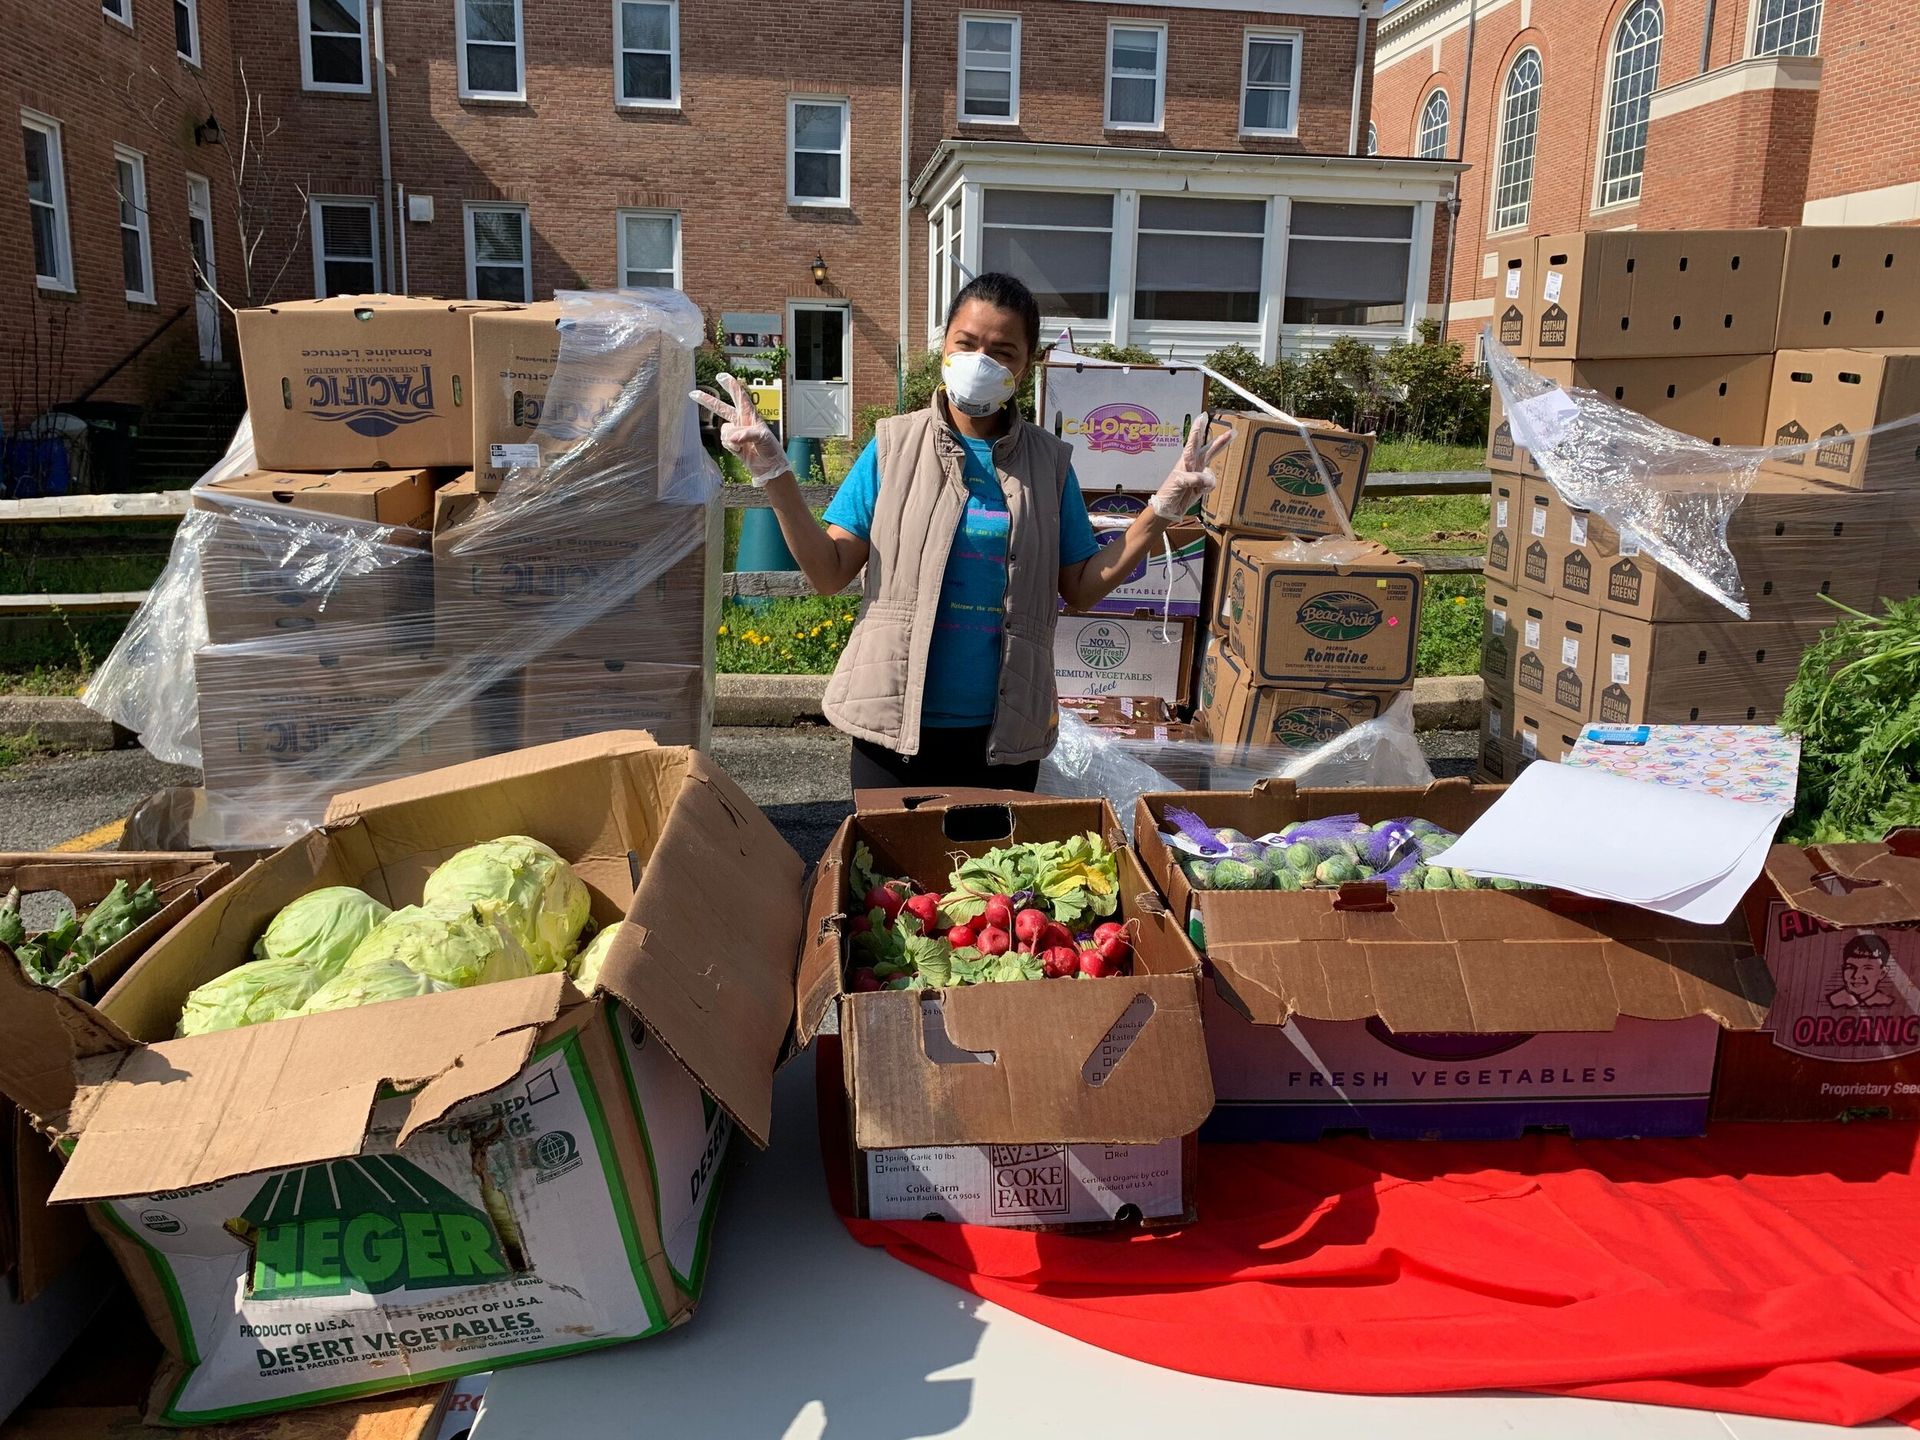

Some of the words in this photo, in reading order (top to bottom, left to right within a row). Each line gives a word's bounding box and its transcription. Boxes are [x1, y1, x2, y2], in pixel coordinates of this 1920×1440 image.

[1502, 320, 1522, 331] GOTHAM
[1543, 320, 1566, 331] GOTHAM
[1501, 331, 1521, 342] GREENS
[1542, 331, 1565, 342] GREENS
[302, 349, 359, 357] Lettuce
[366, 348, 432, 357] Romaine
[357, 366, 419, 374] INTERNATIONAL
[500, 371, 553, 380] ettuce
[306, 364, 435, 409] PACIFIC
[1063, 416, 1180, 442] Cal-Organic
[1820, 450, 1849, 467] GREENS
[1273, 462, 1337, 488] BeachS
[1270, 499, 1326, 519] Romaine
[1527, 553, 1547, 568] GOTHAM
[1526, 564, 1546, 579] GREENS
[1566, 563, 1589, 578] GOTHAM
[1565, 574, 1589, 590] GREENS
[1611, 573, 1640, 590] GOTHAM
[1113, 587, 1169, 595] GETABLES
[1610, 585, 1638, 601] GREENS
[1302, 606, 1377, 627] BeachSide
[1089, 638, 1116, 647] NOVA
[1080, 647, 1102, 656] World
[1103, 648, 1125, 656] Fresh
[1304, 648, 1369, 664] Romaine
[1055, 669, 1093, 679] REMIUM
[1095, 671, 1153, 681] VEGETABLES
[1521, 663, 1543, 679] GOTHAM
[1083, 680, 1118, 696] Select
[1520, 673, 1542, 691] GREENS
[1558, 680, 1581, 696] GOTHAM
[1557, 689, 1580, 708] GREENS
[1603, 696, 1629, 713] GOTHAM
[1602, 707, 1628, 724] GREENS
[1116, 1021, 1137, 1029] rench
[1793, 1015, 1920, 1047] ORGANIC
[1288, 1071, 1389, 1087] FRESH
[1412, 1067, 1617, 1087] VEGETABLES
[1820, 1082, 1891, 1096] Proprietary
[885, 1153, 909, 1163] Spring
[911, 1153, 932, 1161] Garlic
[1114, 1150, 1129, 1158] Red
[885, 1165, 910, 1173] Fennel
[997, 1166, 1063, 1187] COKE
[1081, 1175, 1112, 1184] Certified
[1112, 1174, 1139, 1183] Organic
[1140, 1172, 1150, 1182] by
[906, 1184, 931, 1193] Coke
[934, 1184, 959, 1193] Farm
[1097, 1184, 1124, 1192] Product
[1125, 1182, 1133, 1190] of
[900, 1195, 914, 1203] Juan
[998, 1187, 1064, 1208] FARM
[145, 1214, 170, 1223] USDA
[253, 1212, 507, 1293] HEGER
[417, 1305, 479, 1322] PRODUCT
[481, 1303, 500, 1313] OF
[502, 1296, 544, 1310] U.S.A.
[240, 1324, 292, 1338] PRODUCT
[295, 1322, 312, 1335] OF
[315, 1319, 355, 1332] U.S.A.
[499, 1331, 512, 1339] CA
[256, 1336, 354, 1369] DESERT
[362, 1311, 536, 1350] VEGETABLES
[455, 1344, 487, 1353] CERTIFIED
[488, 1338, 520, 1347] ORGANIC
[259, 1366, 296, 1378] GROWN
[297, 1364, 305, 1372] &
[306, 1358, 340, 1371] PACKED
[341, 1355, 359, 1364] FOR
[361, 1352, 378, 1361] JOE
[379, 1349, 402, 1359] HEG
[407, 1343, 437, 1355] FARMS
